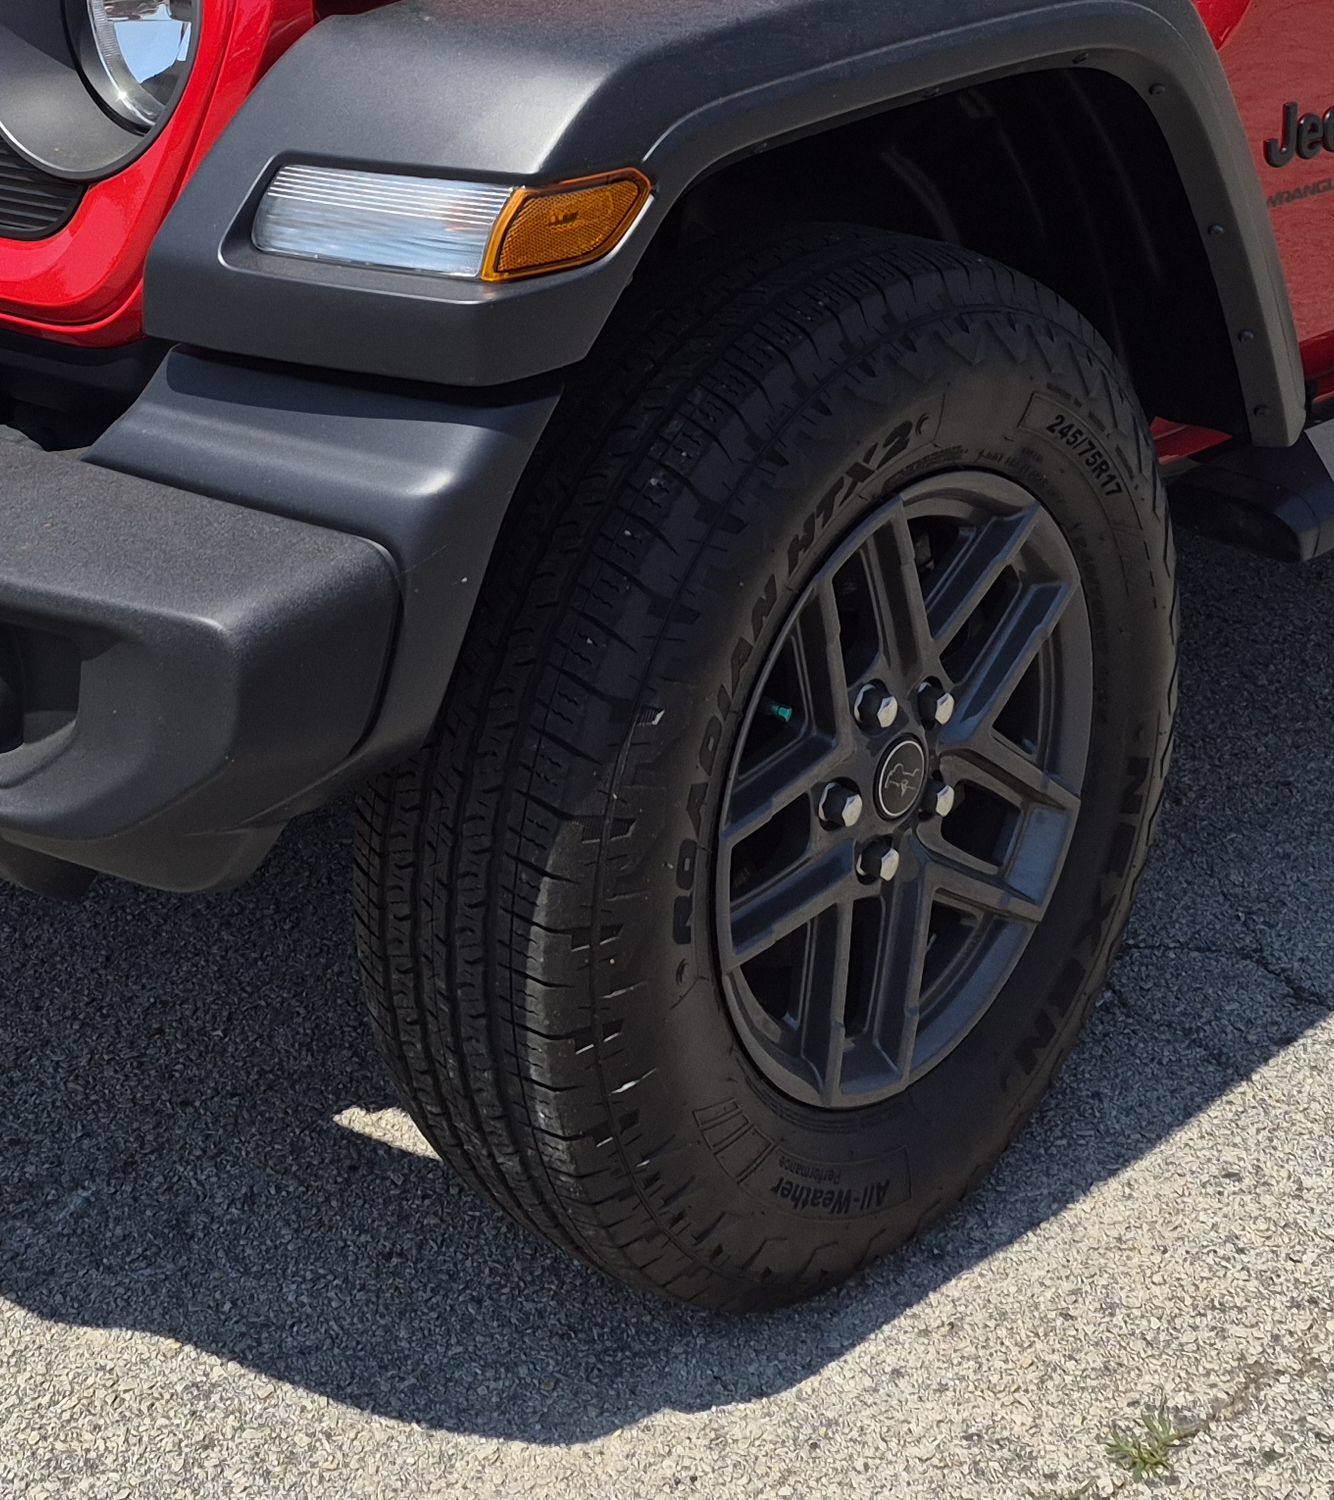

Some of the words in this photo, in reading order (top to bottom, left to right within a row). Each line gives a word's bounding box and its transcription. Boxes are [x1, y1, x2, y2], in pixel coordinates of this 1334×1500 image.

[1046, 414, 1123, 497] 245/75R17
[673, 574, 777, 945] ROADIAN
[788, 419, 913, 578] HTX2
[1015, 756, 1151, 1076] NEXEN
[770, 1177, 891, 1215] All-Weather
[778, 1155, 843, 1184] Performance
